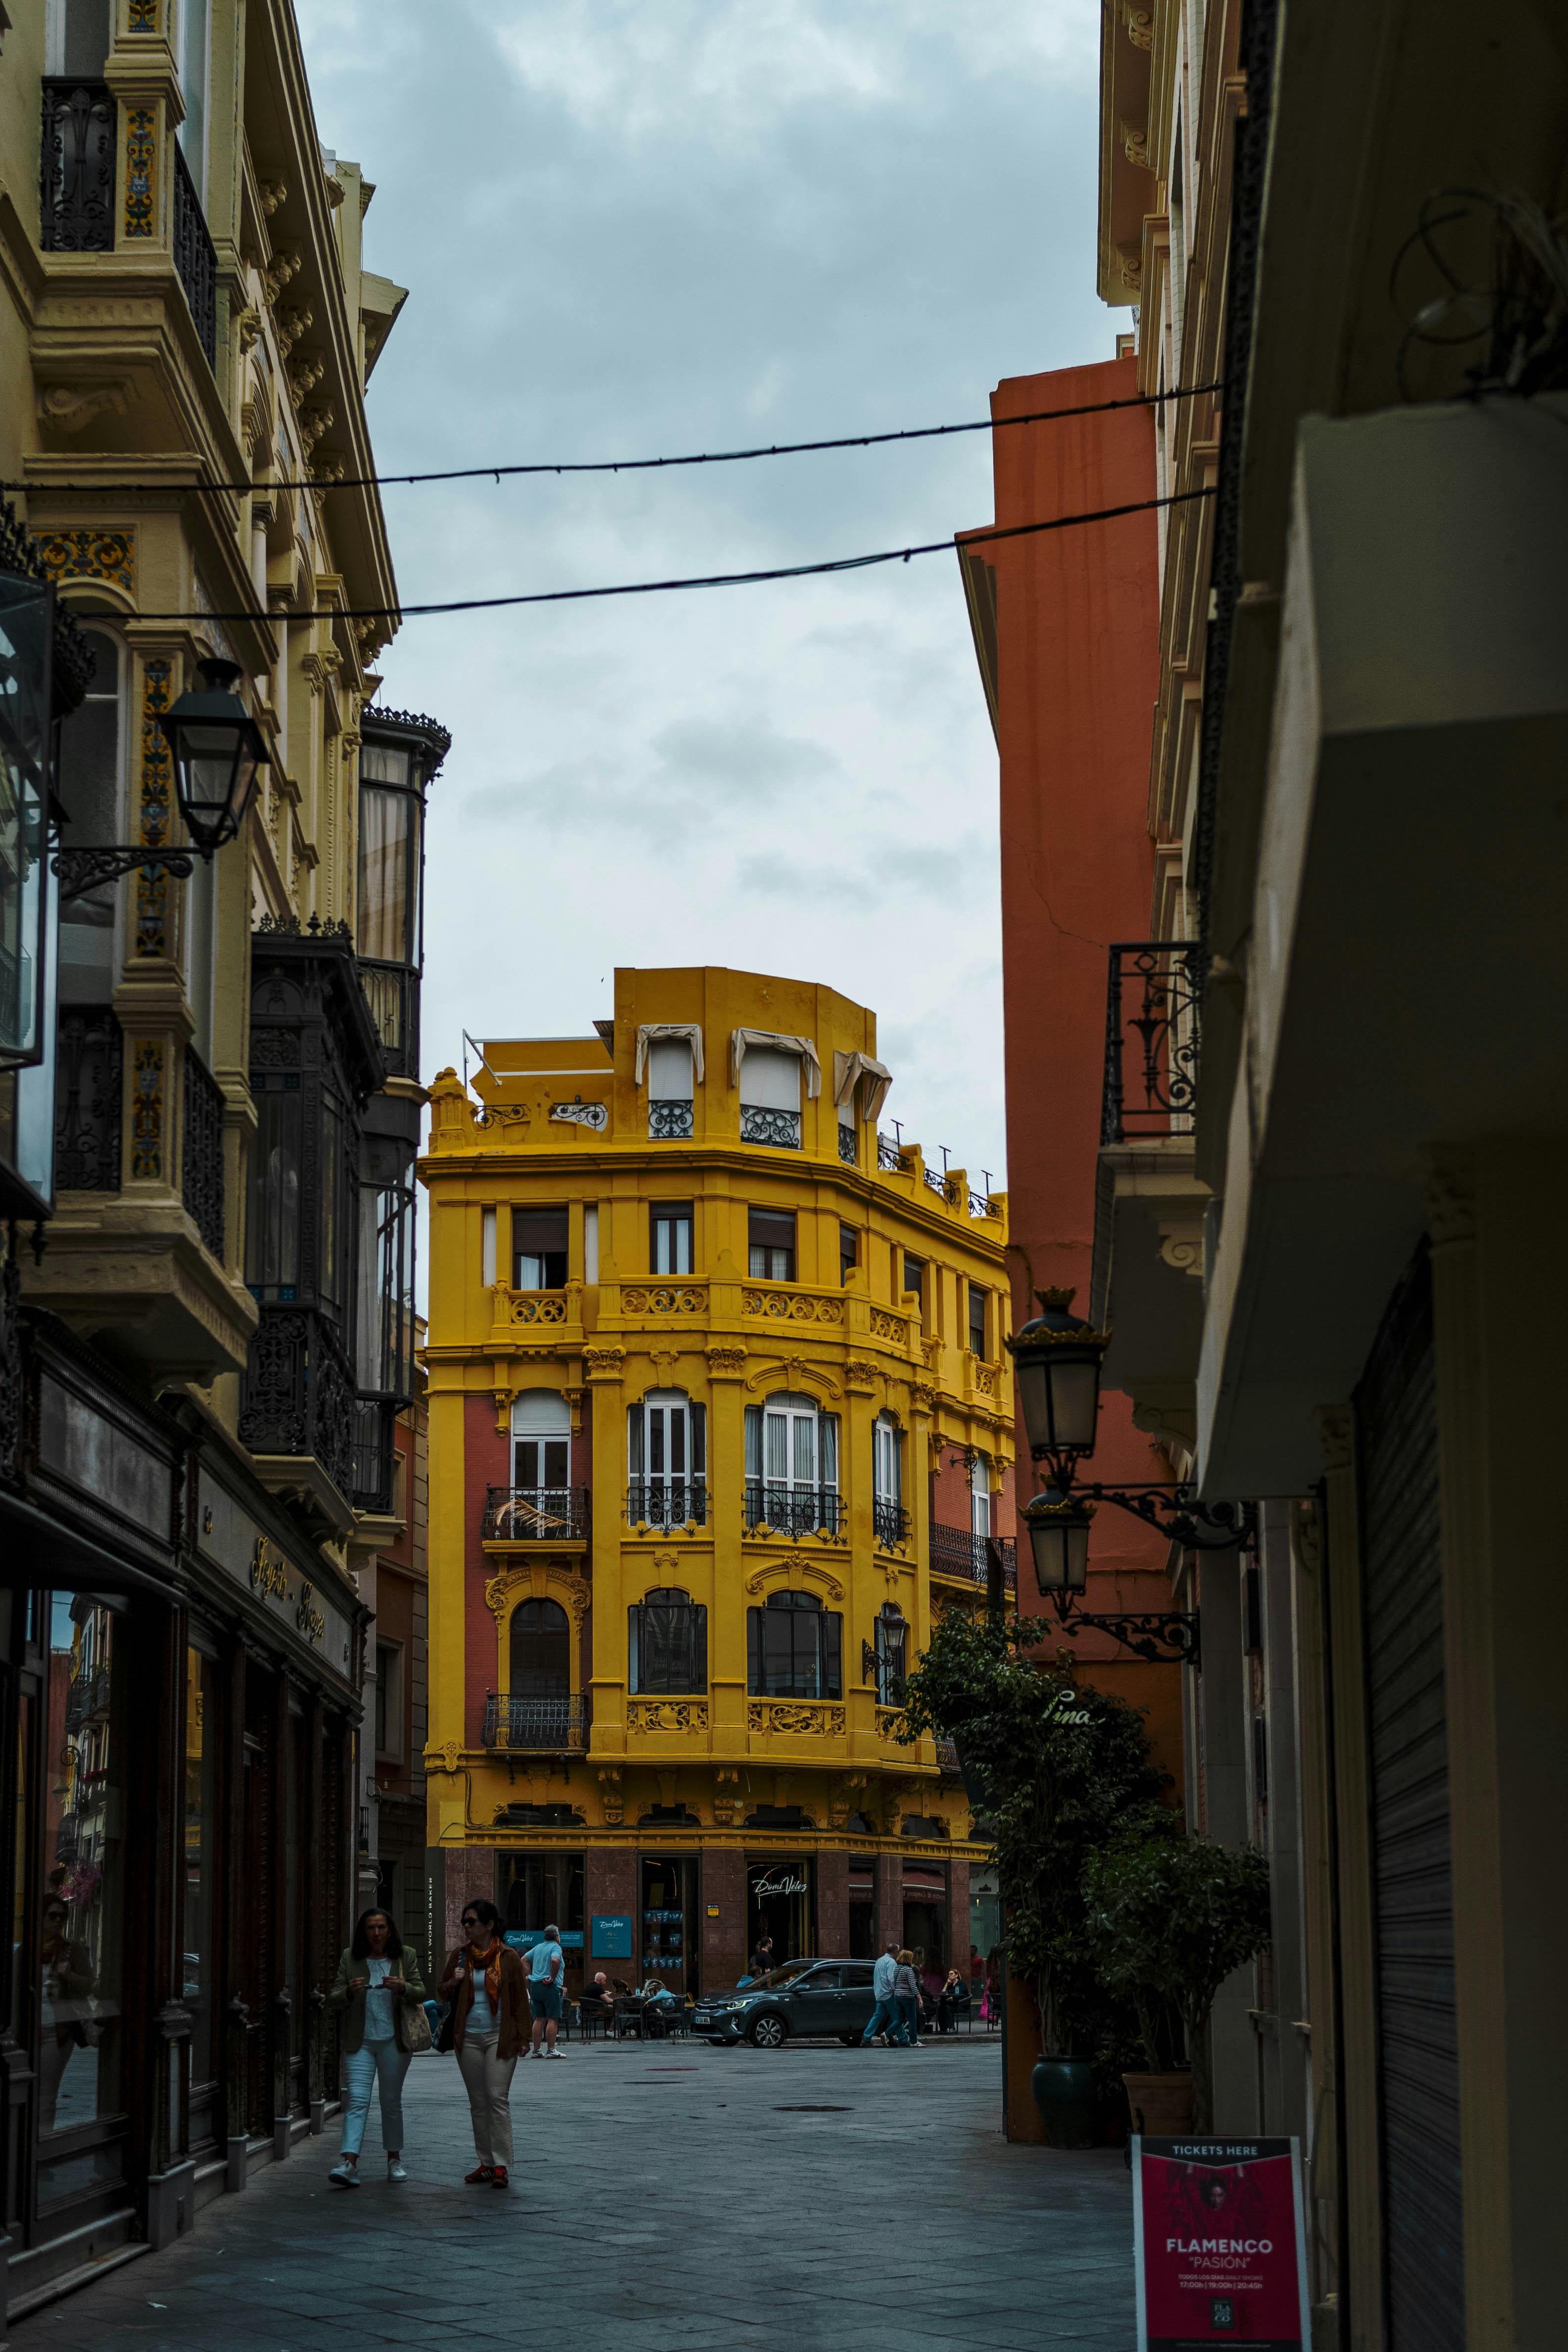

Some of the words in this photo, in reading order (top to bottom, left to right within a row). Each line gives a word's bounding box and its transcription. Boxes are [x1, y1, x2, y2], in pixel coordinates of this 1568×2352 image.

[752, 1880, 783, 1893] Domi
[782, 1875, 807, 1895] Vélez
[1172, 2145, 1223, 2155] TICKETS
[1226, 2146, 1258, 2156] HERE
[1166, 2238, 1273, 2254] FLAMENCO
